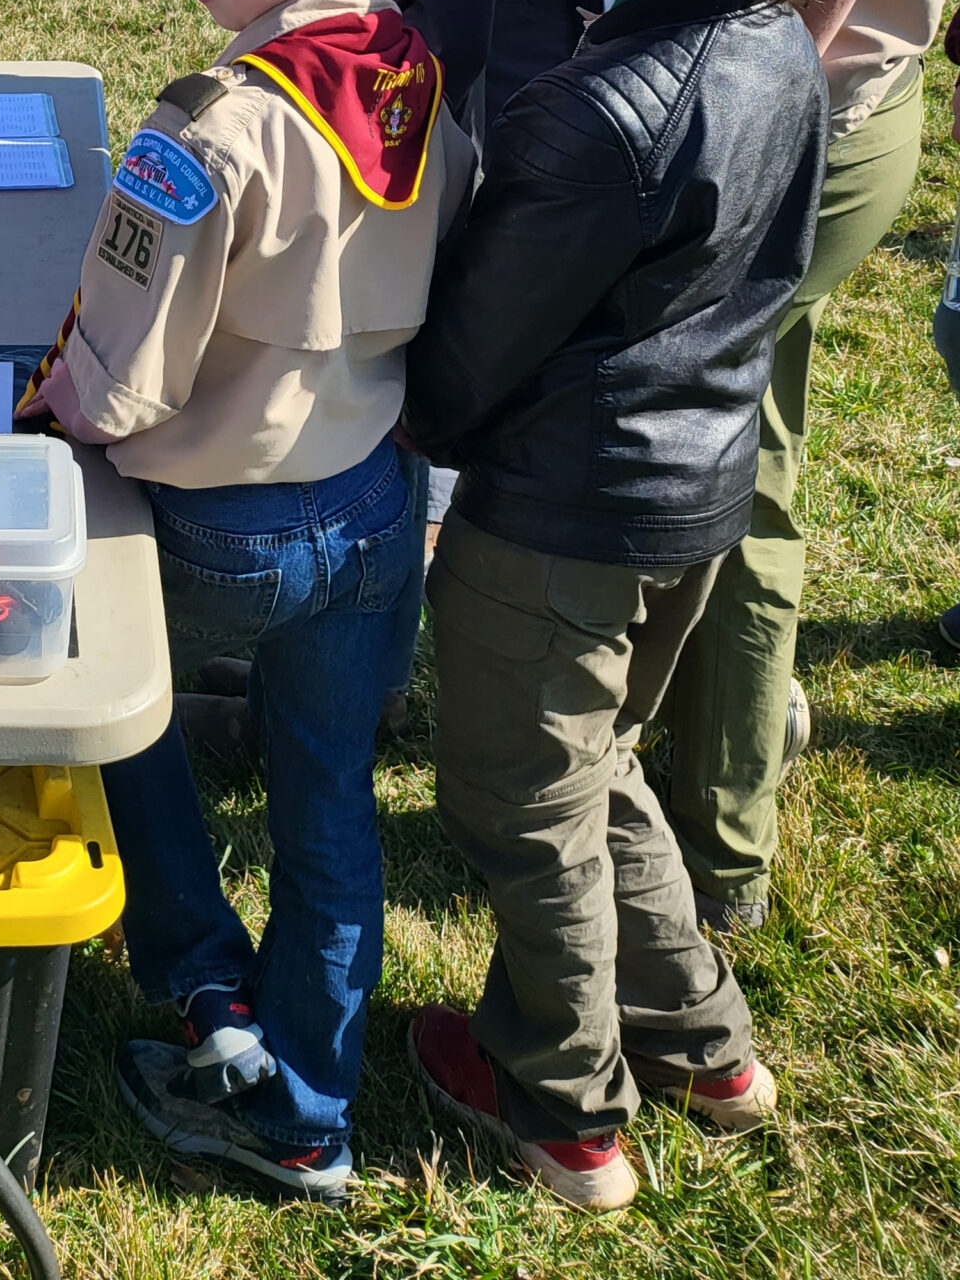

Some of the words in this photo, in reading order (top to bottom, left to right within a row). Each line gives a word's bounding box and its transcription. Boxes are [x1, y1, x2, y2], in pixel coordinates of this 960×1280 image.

[143, 137, 163, 154] CAPITAL
[163, 149, 181, 167] AREA
[180, 164, 208, 197] COUNCIL
[105, 212, 154, 270] 176
